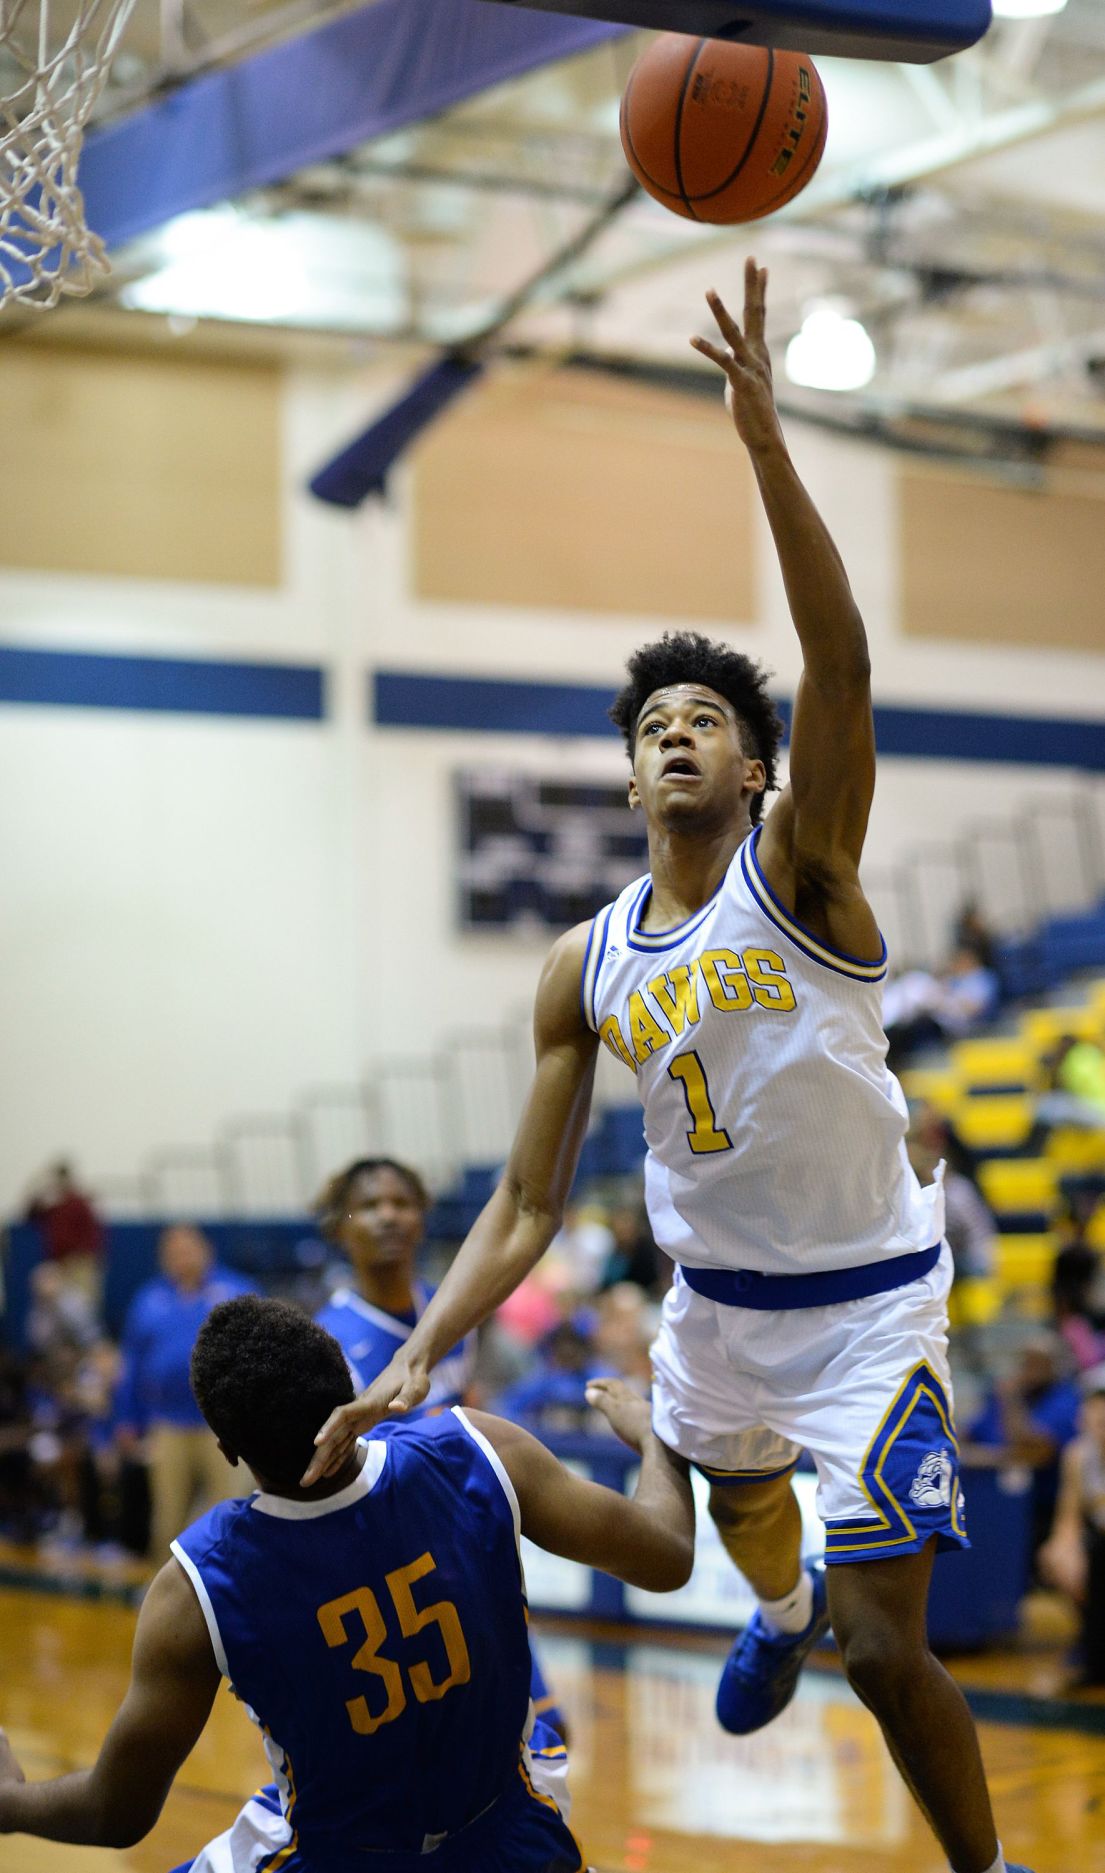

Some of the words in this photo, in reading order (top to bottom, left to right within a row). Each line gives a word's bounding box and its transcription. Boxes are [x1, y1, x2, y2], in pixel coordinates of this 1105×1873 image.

[768, 64, 812, 177] ELITE
[599, 946, 798, 1074] DAWGS
[666, 1049, 735, 1155] 1
[315, 1550, 472, 1735] 35
